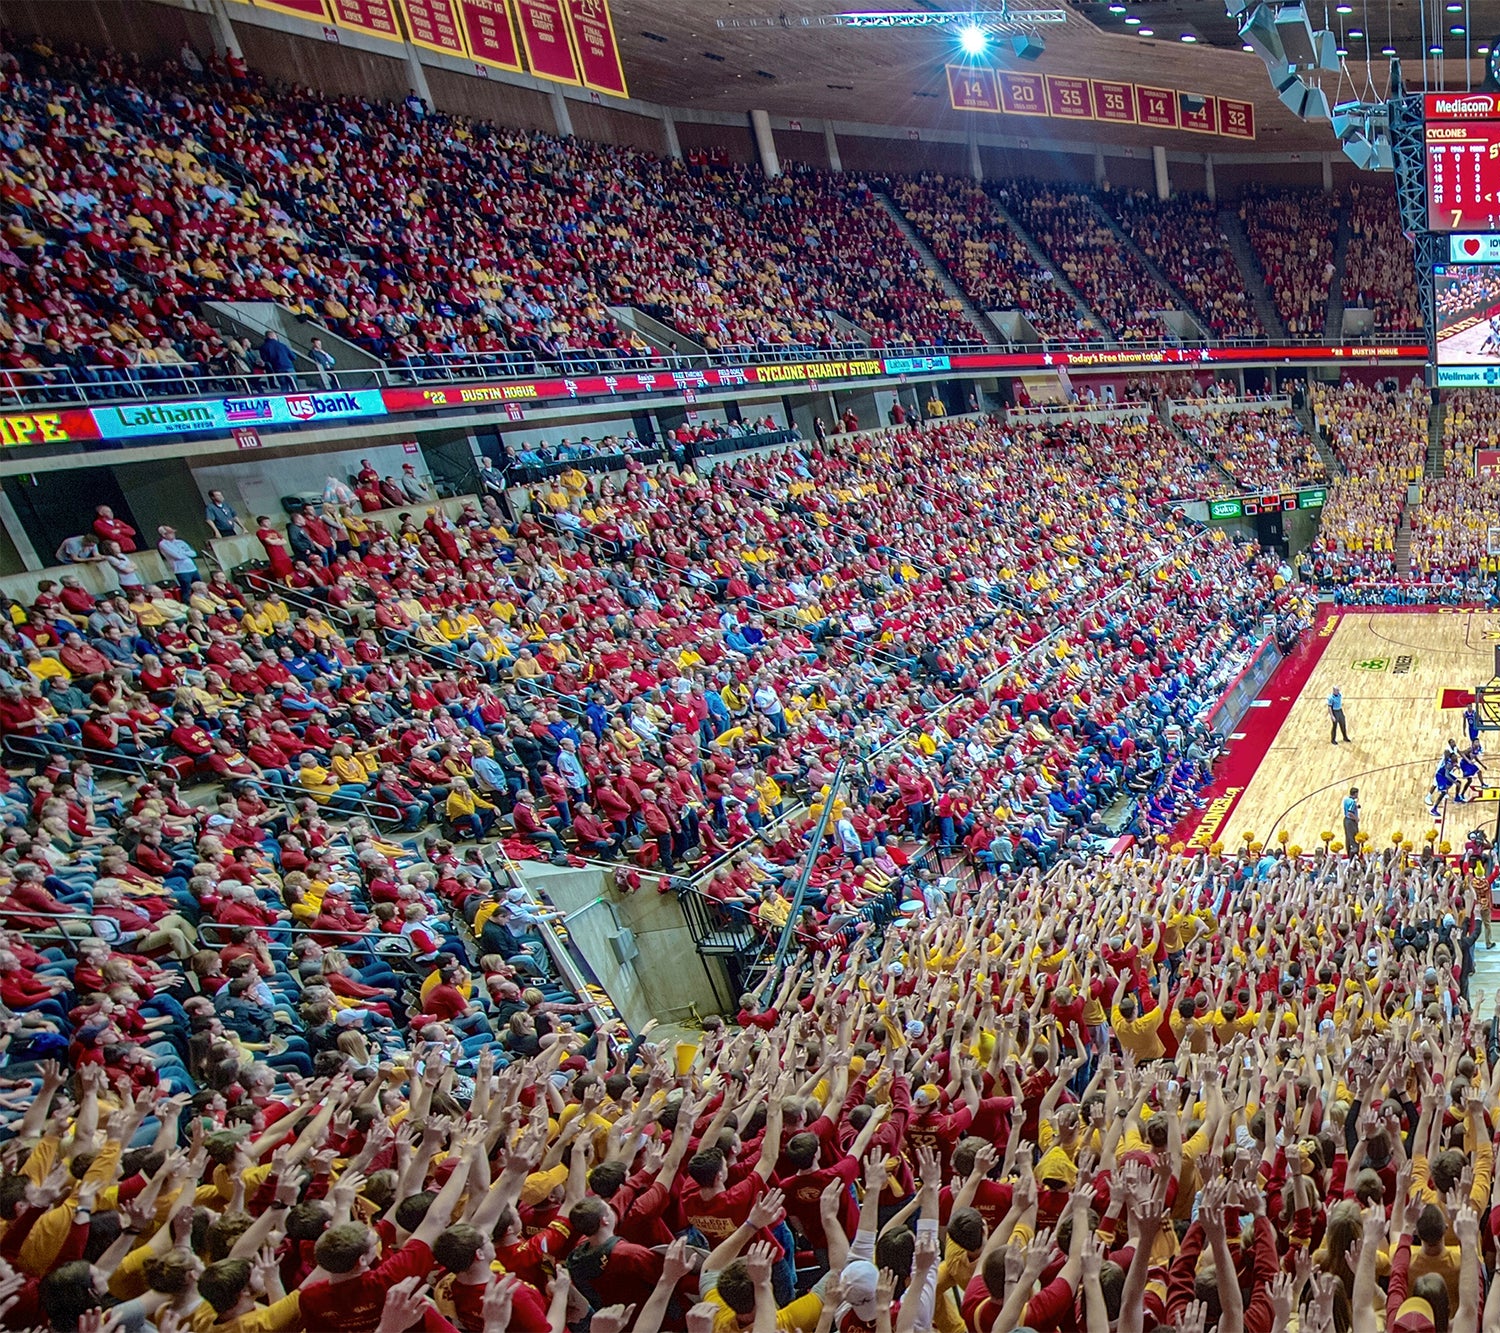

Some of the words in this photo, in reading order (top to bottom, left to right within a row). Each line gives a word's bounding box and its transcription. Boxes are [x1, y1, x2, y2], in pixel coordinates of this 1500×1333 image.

[964, 80, 982, 97] 14
[1012, 85, 1034, 101] 20
[1060, 90, 1082, 106] 35
[1105, 93, 1124, 110] 35
[1436, 98, 1491, 113] Mediacom
[1149, 99, 1165, 115] 14
[1228, 111, 1246, 127] 32
[1427, 128, 1467, 138] CYCLONES
[1433, 153, 1442, 162] 11
[1455, 153, 1460, 162] 0
[1475, 153, 1480, 162] 2
[1474, 163, 1480, 172] 0
[1434, 184, 1443, 193] 22
[1455, 184, 1461, 193] 0
[1456, 194, 1461, 203] 0
[1475, 194, 1481, 203] 0
[1451, 209, 1462, 228] 7
[1067, 354, 1098, 365] Today's
[1100, 353, 1117, 363] Free
[1117, 352, 1142, 363] throw
[1352, 348, 1376, 356] DUSTIN
[756, 364, 804, 383] CYCLONE
[806, 361, 849, 380] CHARITY
[849, 360, 881, 376] STRIPE
[1439, 371, 1480, 381] Wellmark
[423, 391, 446, 404] #22
[461, 387, 502, 402] DUSTIN
[504, 385, 537, 399] HOGUE
[117, 405, 213, 428] Latham
[223, 398, 270, 412] STELLAR
[239, 437, 258, 448] 110
